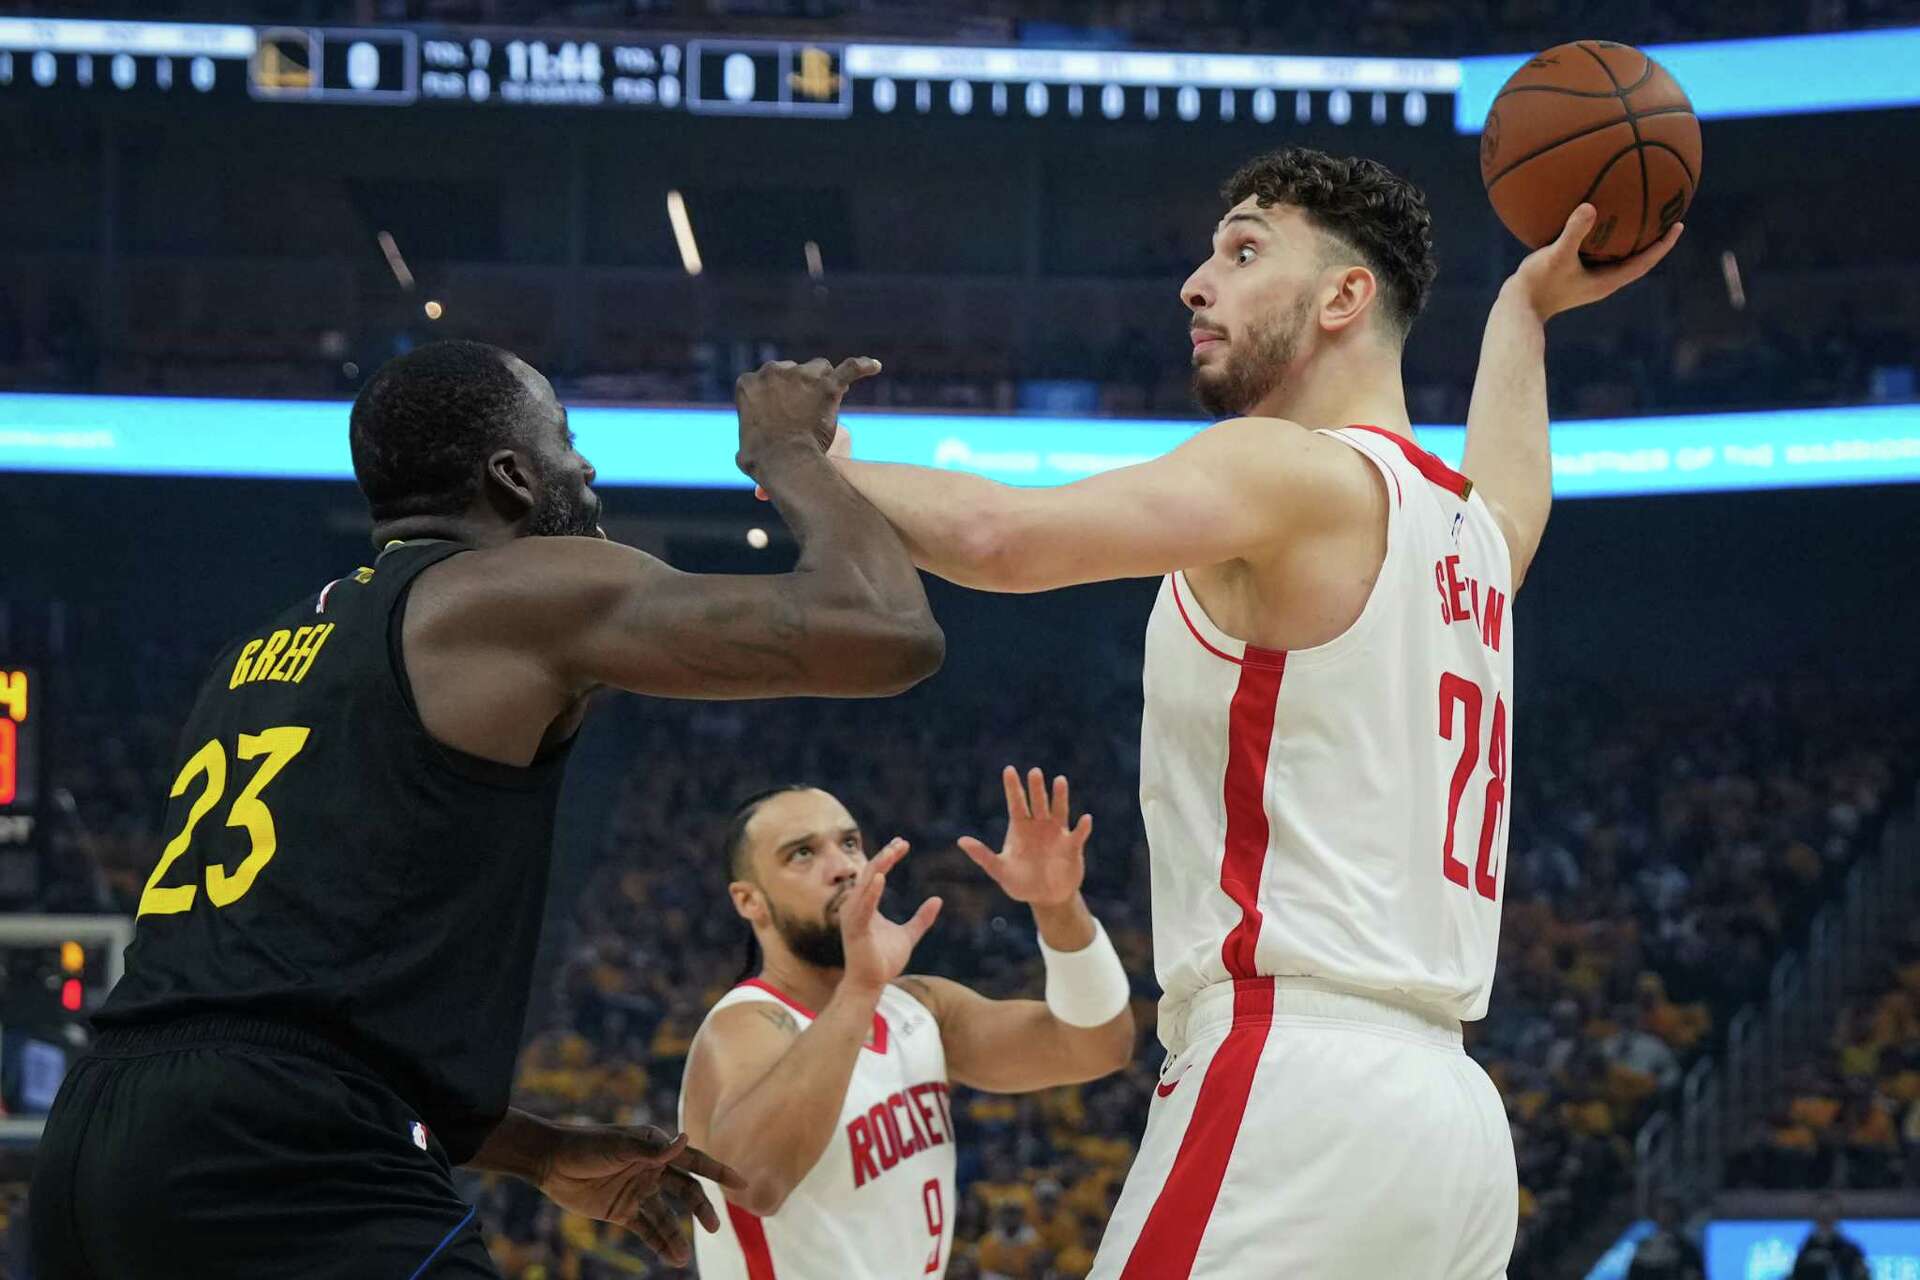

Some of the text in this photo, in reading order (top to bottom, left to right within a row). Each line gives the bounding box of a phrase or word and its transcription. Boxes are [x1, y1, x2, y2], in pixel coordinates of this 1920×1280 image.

[347, 41, 380, 91] 0
[723, 53, 756, 102] 0
[136, 726, 311, 922] 23
[1439, 671, 1506, 901] 28
[923, 1177, 944, 1275] 9
